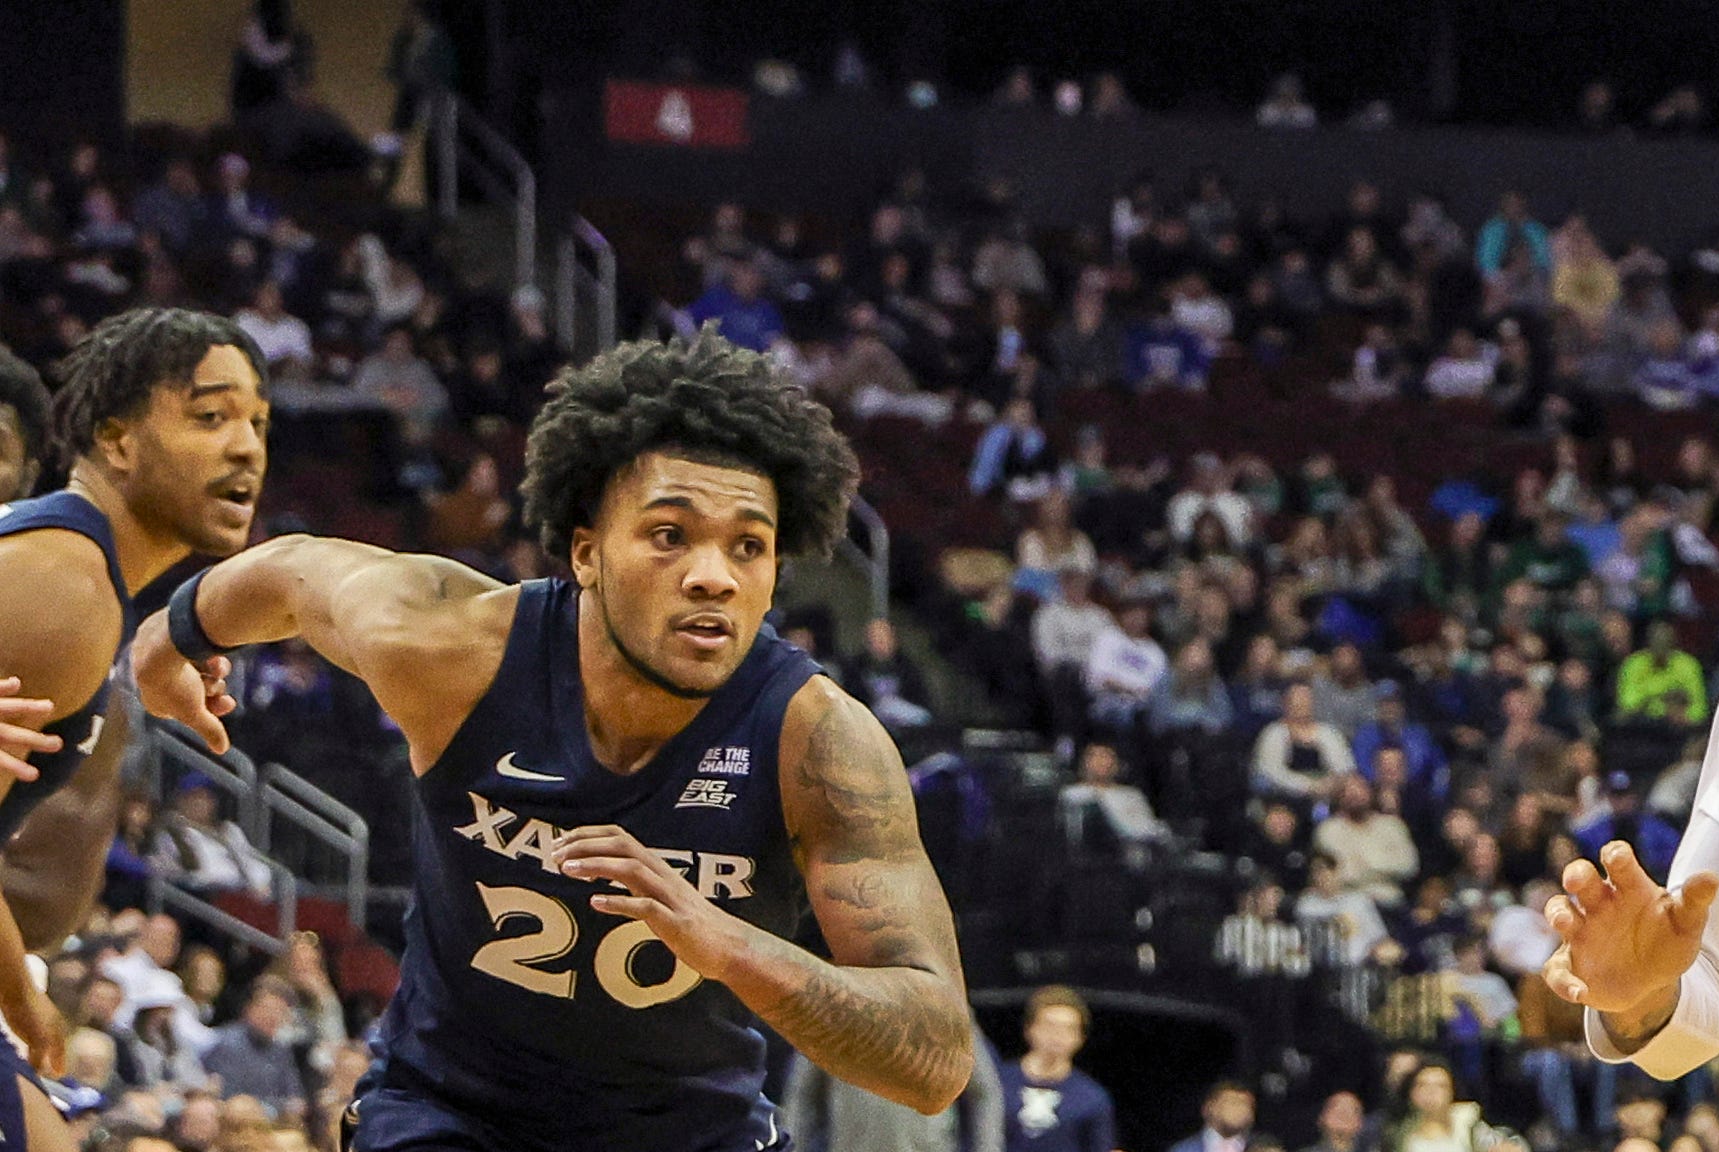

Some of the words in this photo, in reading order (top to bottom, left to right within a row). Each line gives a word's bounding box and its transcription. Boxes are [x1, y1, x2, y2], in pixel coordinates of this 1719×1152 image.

[725, 747, 751, 762] THE
[697, 760, 751, 775] CHANGE
[686, 779, 728, 793] BIG
[679, 790, 737, 805] EAST
[453, 791, 757, 901] XAR
[470, 880, 705, 1010] 20
